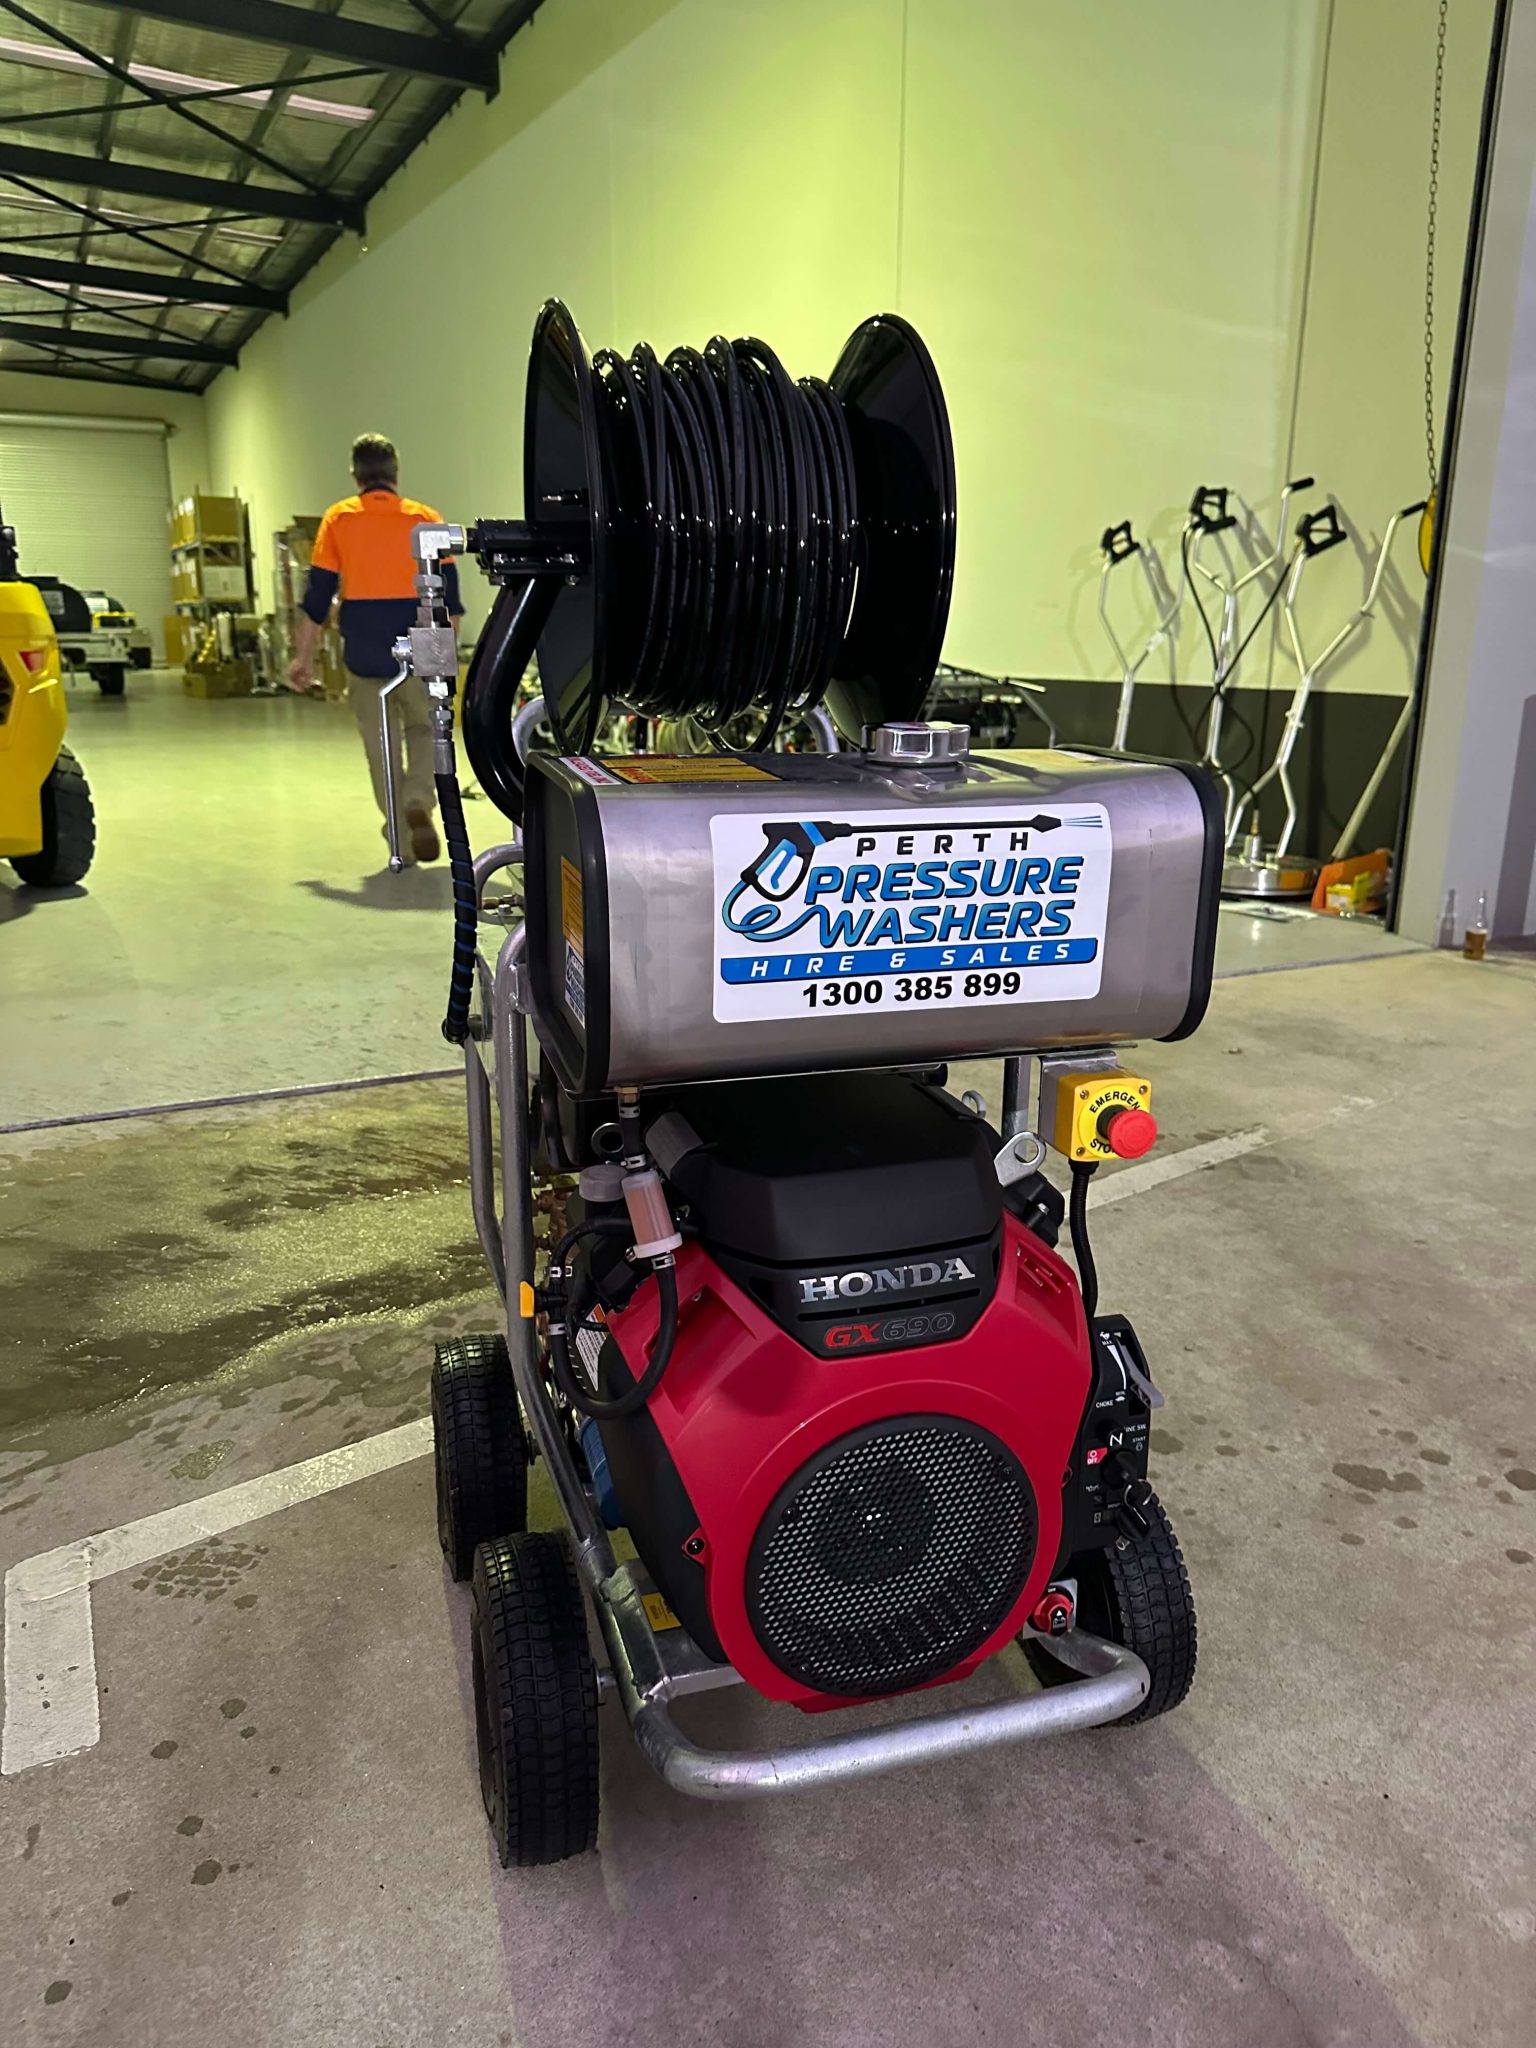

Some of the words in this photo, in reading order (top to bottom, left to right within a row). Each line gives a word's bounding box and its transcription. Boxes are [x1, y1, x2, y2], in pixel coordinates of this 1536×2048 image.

[856, 831, 1029, 857] PERTH
[804, 856, 1085, 905] PRESSURE
[816, 899, 1075, 948] WASHERS
[750, 955, 856, 977] HIRE
[889, 952, 906, 968] &
[940, 943, 1070, 965] SALES
[802, 980, 883, 1008] 1300
[894, 976, 953, 1002] 385
[963, 971, 1021, 996] 899
[1089, 1091, 1141, 1113] EMERGEN
[1090, 1138, 1116, 1154] STO
[798, 1257, 976, 1303] HONDA
[1096, 1400, 1114, 1409] CHOKE
